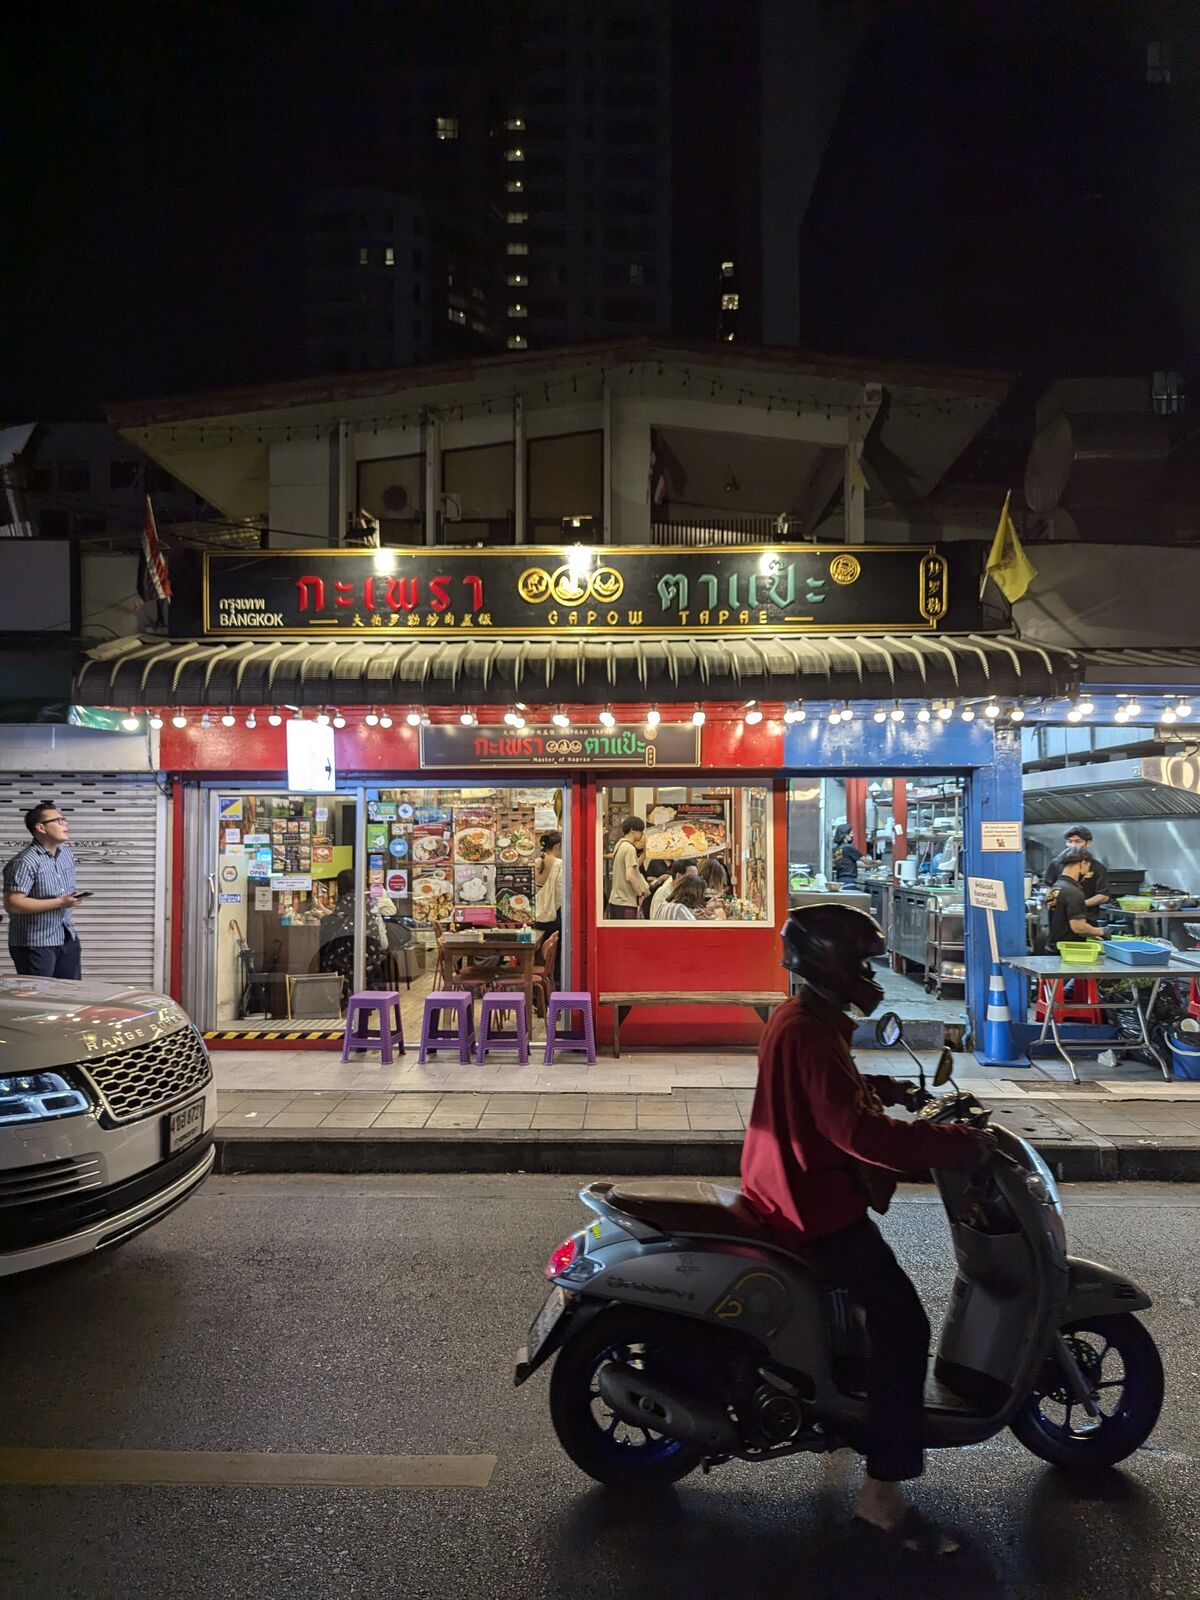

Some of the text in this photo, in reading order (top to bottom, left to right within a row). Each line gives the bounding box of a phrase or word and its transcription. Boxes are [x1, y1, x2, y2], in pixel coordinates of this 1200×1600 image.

[295, 575, 484, 613] กะเพรา
[219, 598, 265, 614] กรุงเทพ
[219, 613, 284, 627] BANGKOK
[548, 610, 768, 625] GAPOW TAPAE
[474, 736, 543, 757] กะเพรา
[584, 731, 646, 756] ตาแป๊ะ
[85, 1013, 185, 1052] RANGE ROVER
